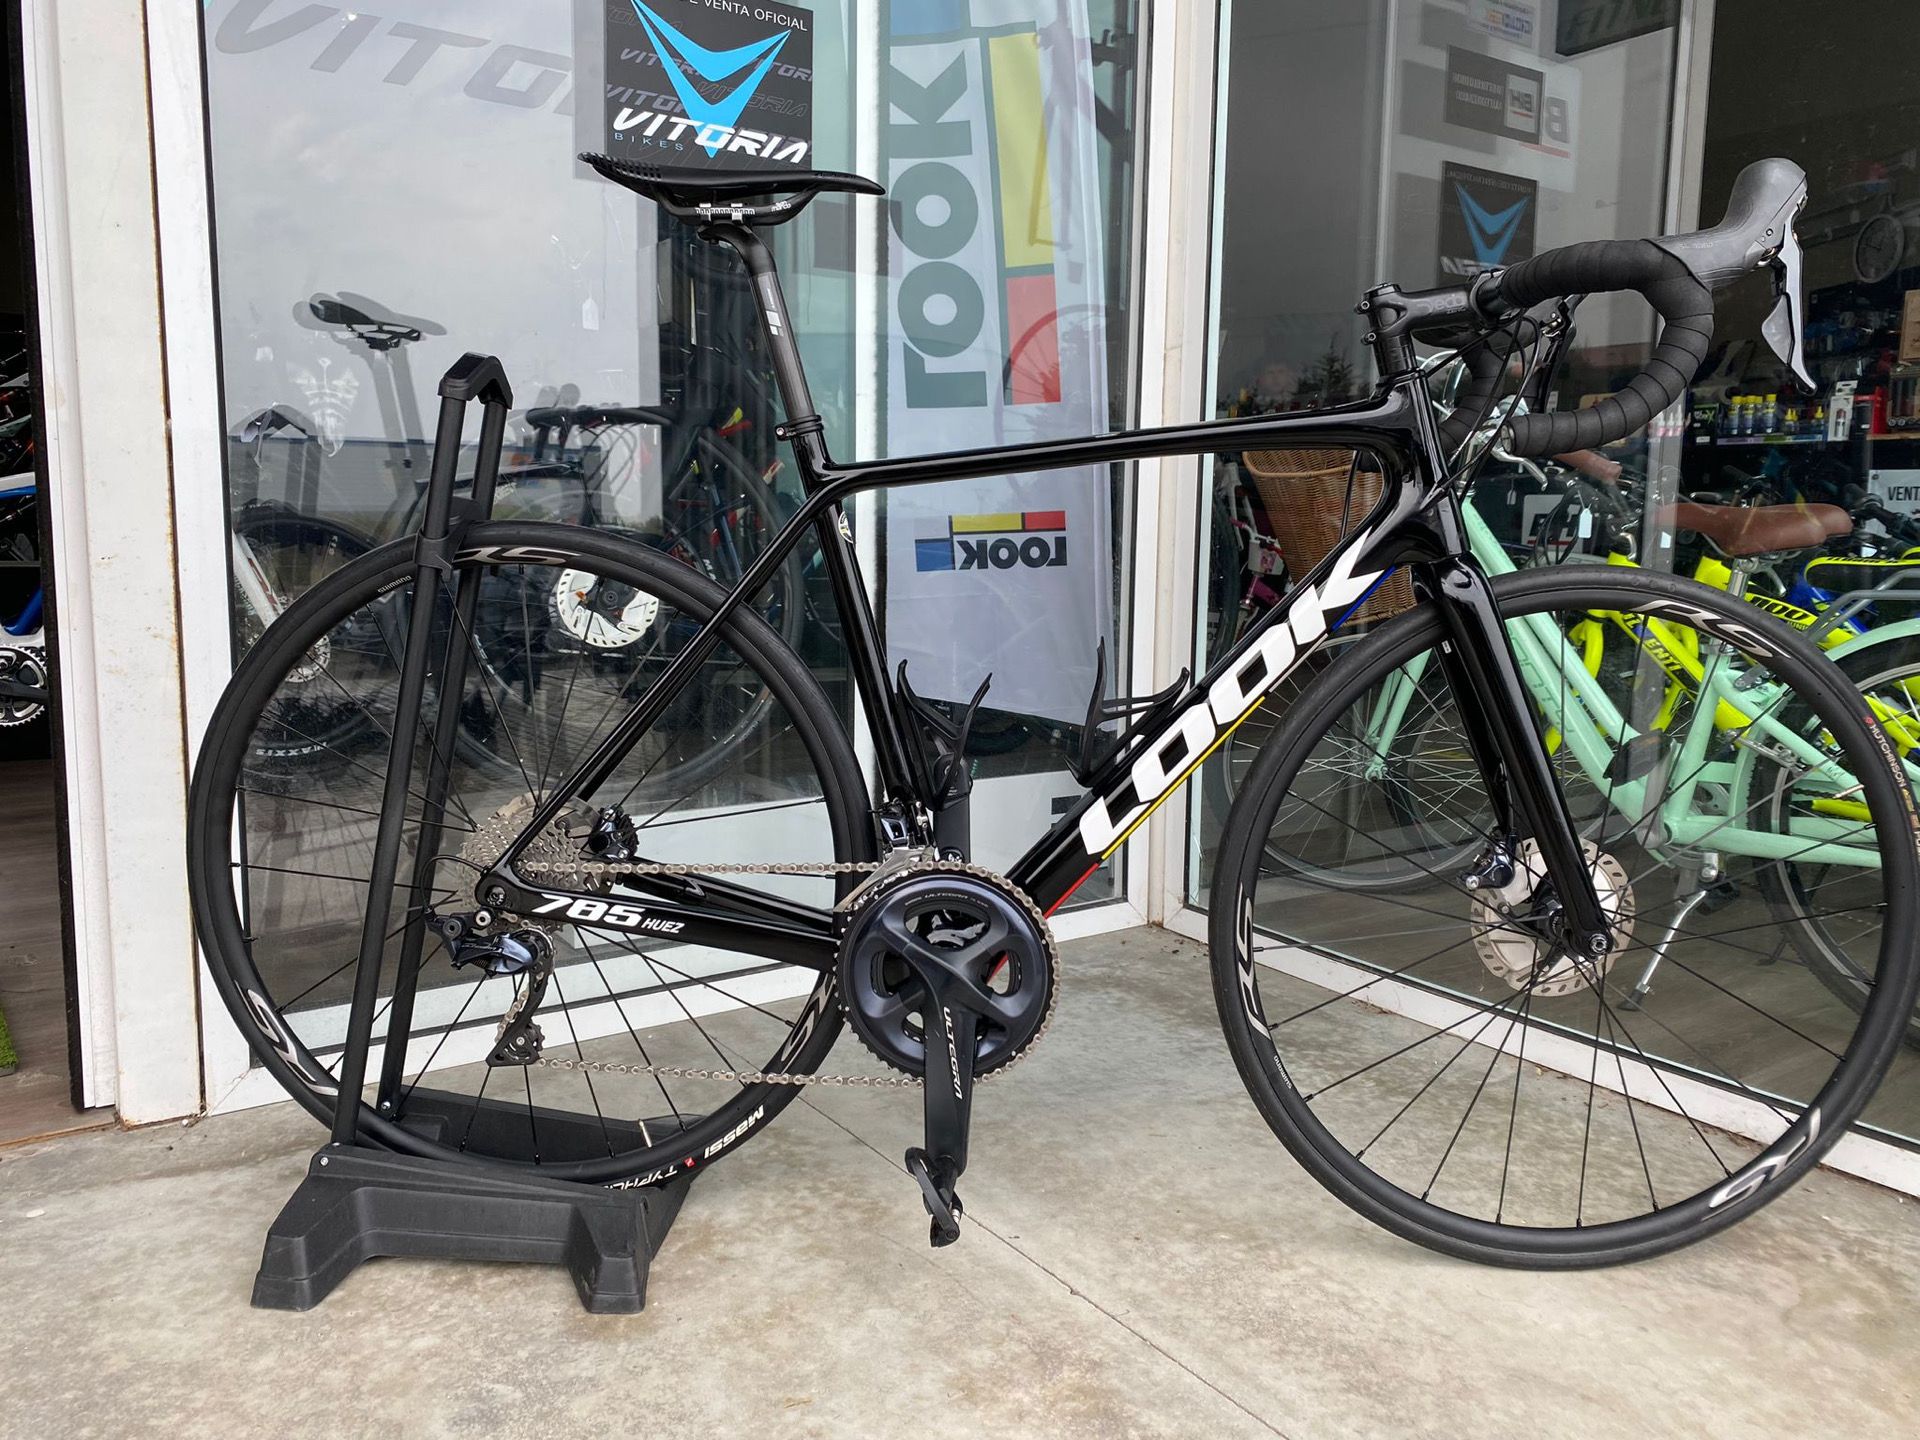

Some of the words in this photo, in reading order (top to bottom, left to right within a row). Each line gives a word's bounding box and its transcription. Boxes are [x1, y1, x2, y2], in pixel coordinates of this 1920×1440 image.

[704, 0, 750, 17] VENTA
[754, 8, 808, 31] OFICIAL
[215, 0, 574, 117] VITO
[613, 107, 808, 163] VITORIA
[615, 132, 683, 151] BIKES
[1079, 526, 1385, 855] LOOK
[1869, 723, 1907, 788] HUTCHINSON
[532, 893, 645, 927] 785
[641, 918, 685, 934] HUEZ
[943, 1006, 963, 1100] ULTEGRA
